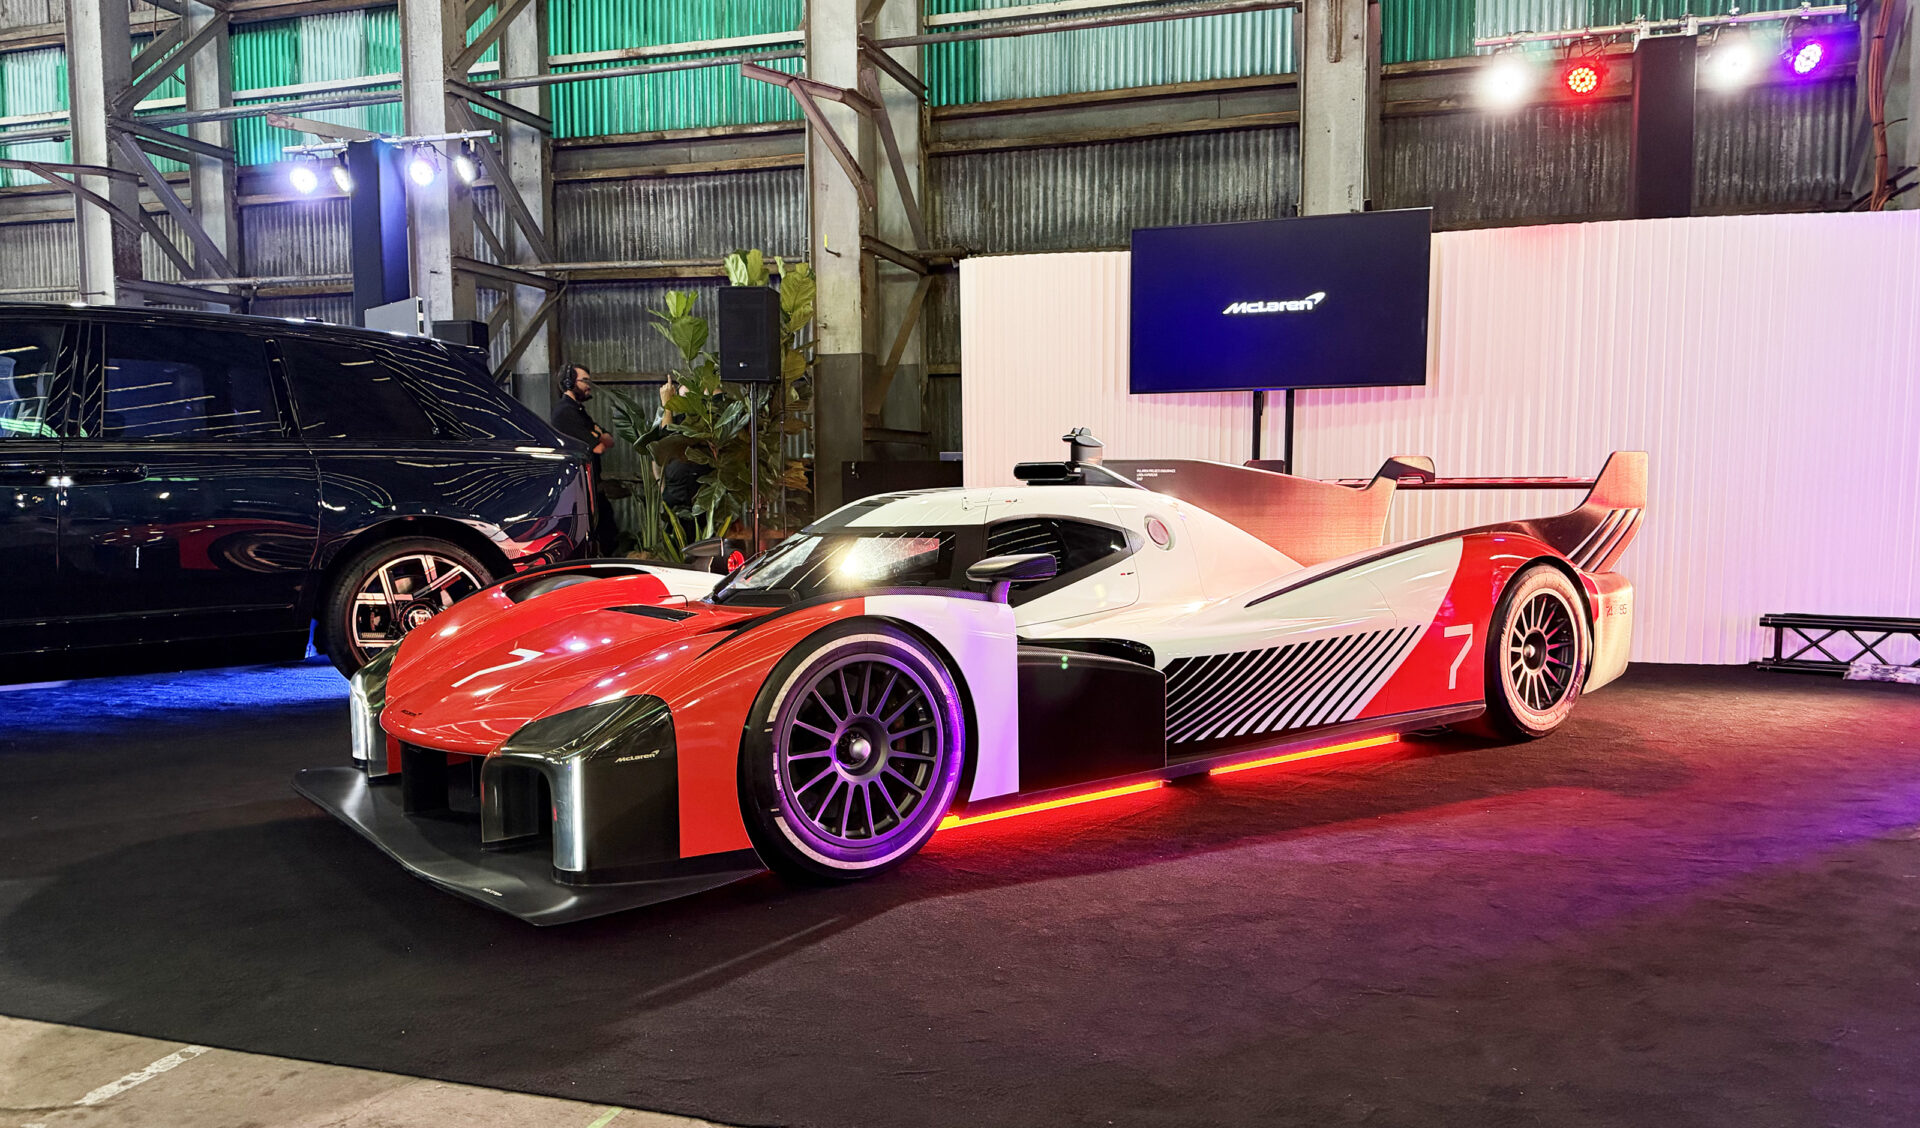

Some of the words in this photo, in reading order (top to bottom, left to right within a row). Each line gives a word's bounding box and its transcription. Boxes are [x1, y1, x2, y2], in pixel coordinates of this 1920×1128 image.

[1223, 292, 1325, 314] McLaren
[451, 648, 545, 688] 7
[1444, 624, 1473, 689] 7
[614, 749, 660, 763] McLaren
